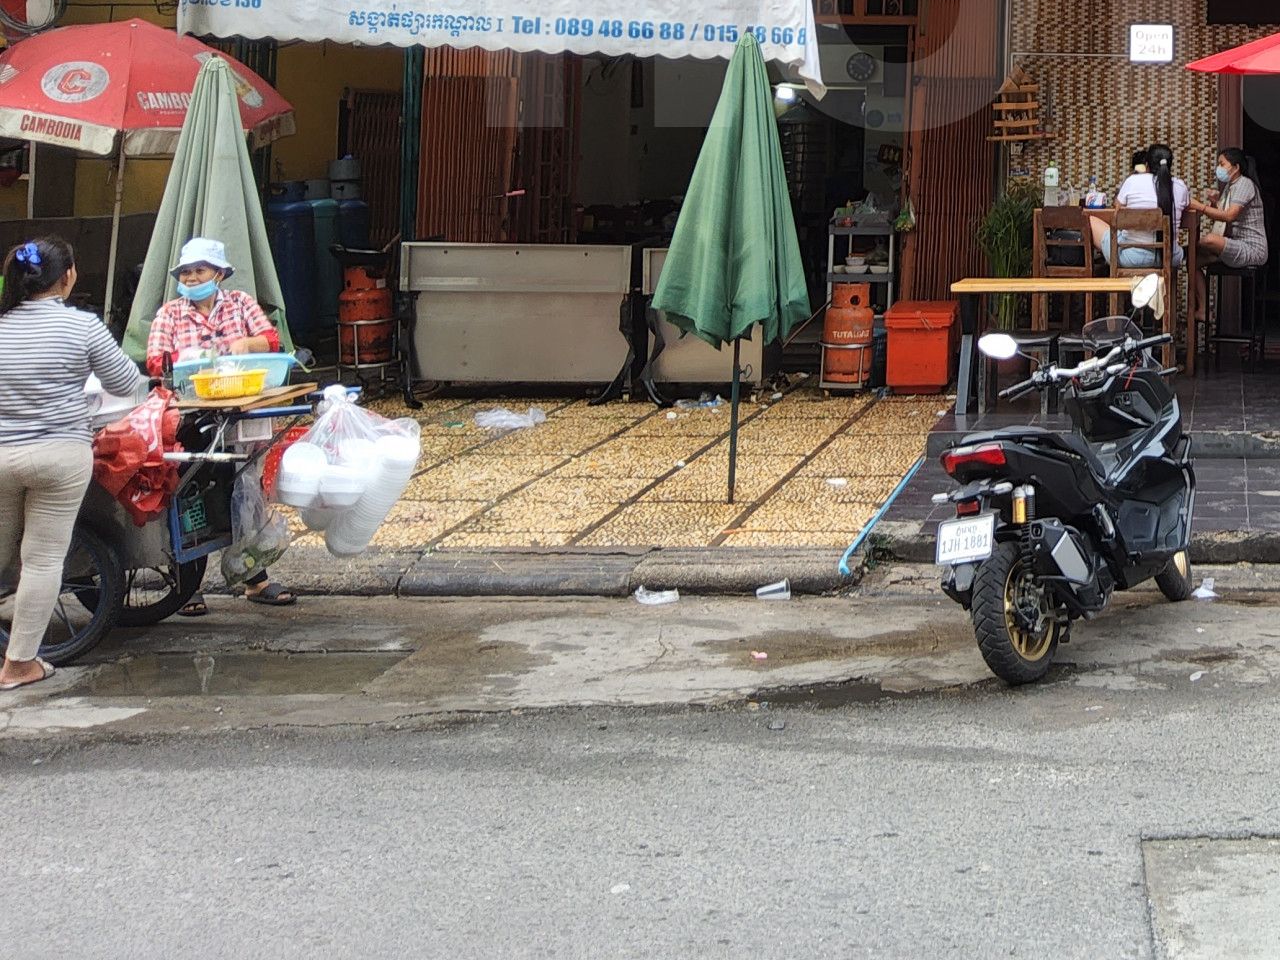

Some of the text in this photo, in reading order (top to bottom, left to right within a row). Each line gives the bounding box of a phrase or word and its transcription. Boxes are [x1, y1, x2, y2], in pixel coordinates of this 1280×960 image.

[512, 15, 541, 33] Tel
[555, 17, 594, 36] 089
[599, 19, 623, 38] 48
[628, 20, 654, 39] 66
[659, 21, 685, 40] 88
[689, 24, 698, 41] /
[704, 23, 738, 42] 015
[771, 26, 793, 44] 66
[1135, 30, 1169, 41] Open
[1138, 44, 1166, 55] 24h
[20, 114, 82, 141] CAMBODIA
